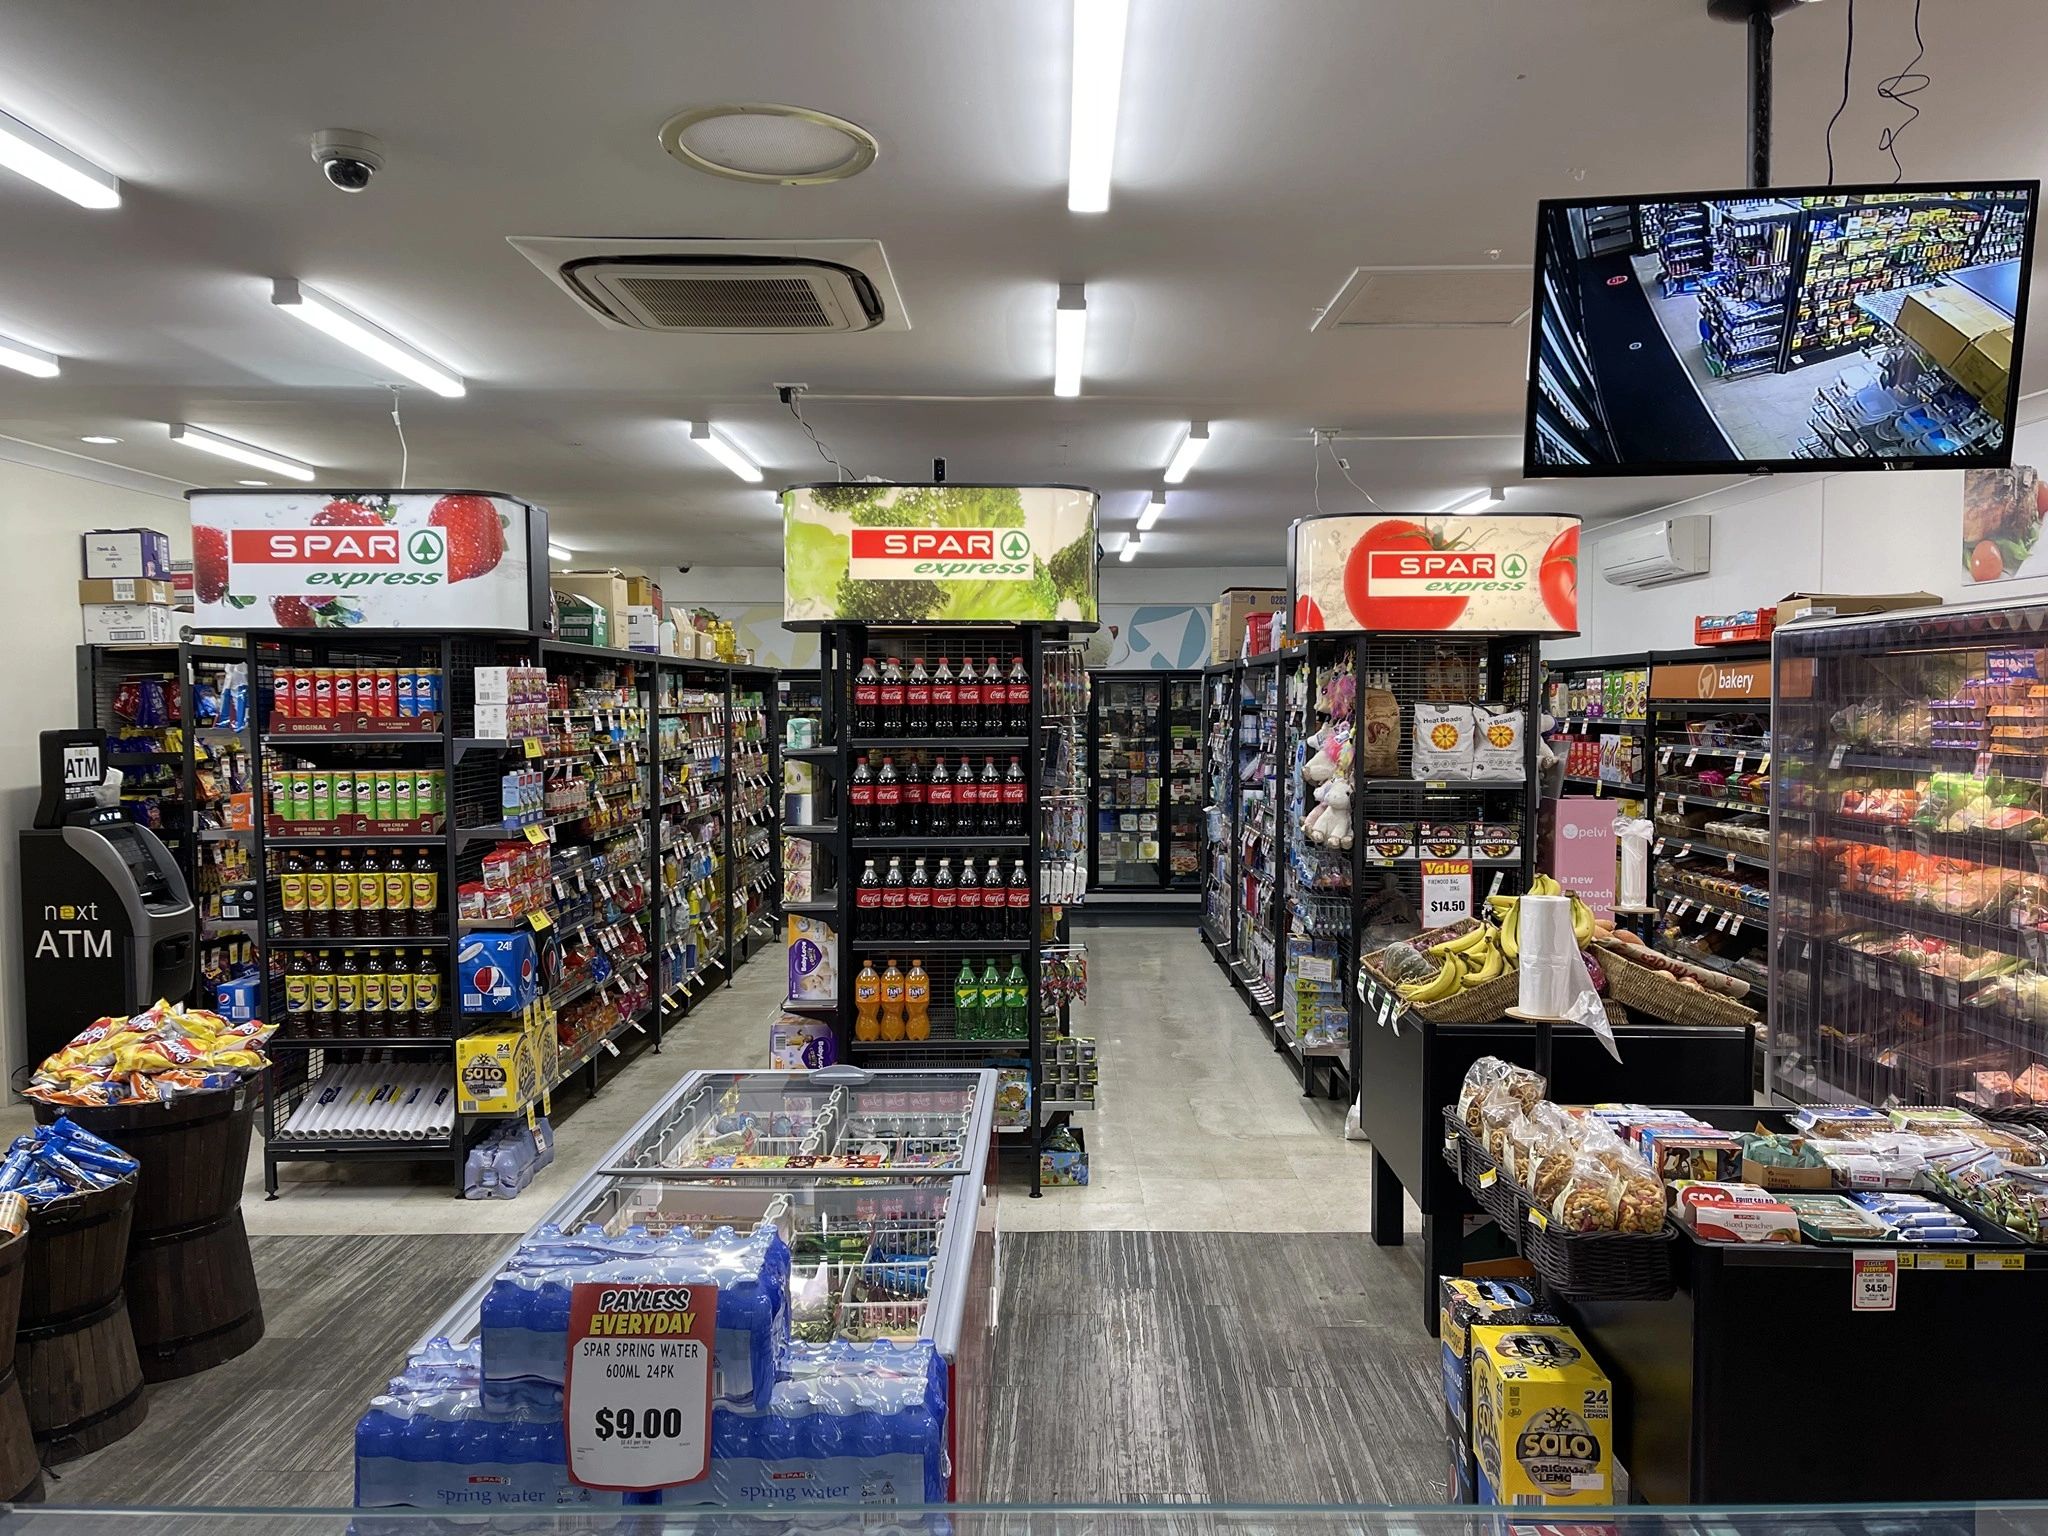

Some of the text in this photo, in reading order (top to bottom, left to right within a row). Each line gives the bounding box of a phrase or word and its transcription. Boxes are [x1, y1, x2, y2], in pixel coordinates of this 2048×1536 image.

[269, 535, 396, 558] SPAR
[884, 535, 991, 554] SPAR
[913, 562, 1030, 578] express
[1400, 557, 1493, 575] SPAR
[305, 571, 443, 589] express
[1425, 581, 1527, 594] express
[1718, 669, 1754, 694] bakery
[1494, 718, 1516, 726] Beads
[65, 757, 98, 778] ATM
[100, 811, 121, 821] ATM
[1578, 828, 1607, 840] pelvi
[1425, 862, 1470, 874] Value
[1562, 876, 1594, 884] a new
[44, 902, 98, 920] next
[1431, 900, 1465, 912] $14.50
[35, 930, 112, 958] ATM
[497, 941, 508, 950] 24
[465, 1068, 502, 1080] SOLO
[1865, 1284, 1887, 1292] $4.50
[600, 1288, 692, 1312] PAYLESS
[590, 1312, 696, 1336] EVERYDAY
[583, 1342, 698, 1358] SPAR SPRING WATER
[606, 1364, 674, 1378] 600ML 24PK
[1584, 1390, 1608, 1404] 24
[595, 1407, 682, 1441] $9.00
[1524, 1434, 1592, 1458] SOLO
[1532, 1464, 1587, 1474] ORIGINAL
[1540, 1473, 1571, 1482] LEMO
[437, 1488, 545, 1504] spring water
[740, 1484, 849, 1500] spring water
